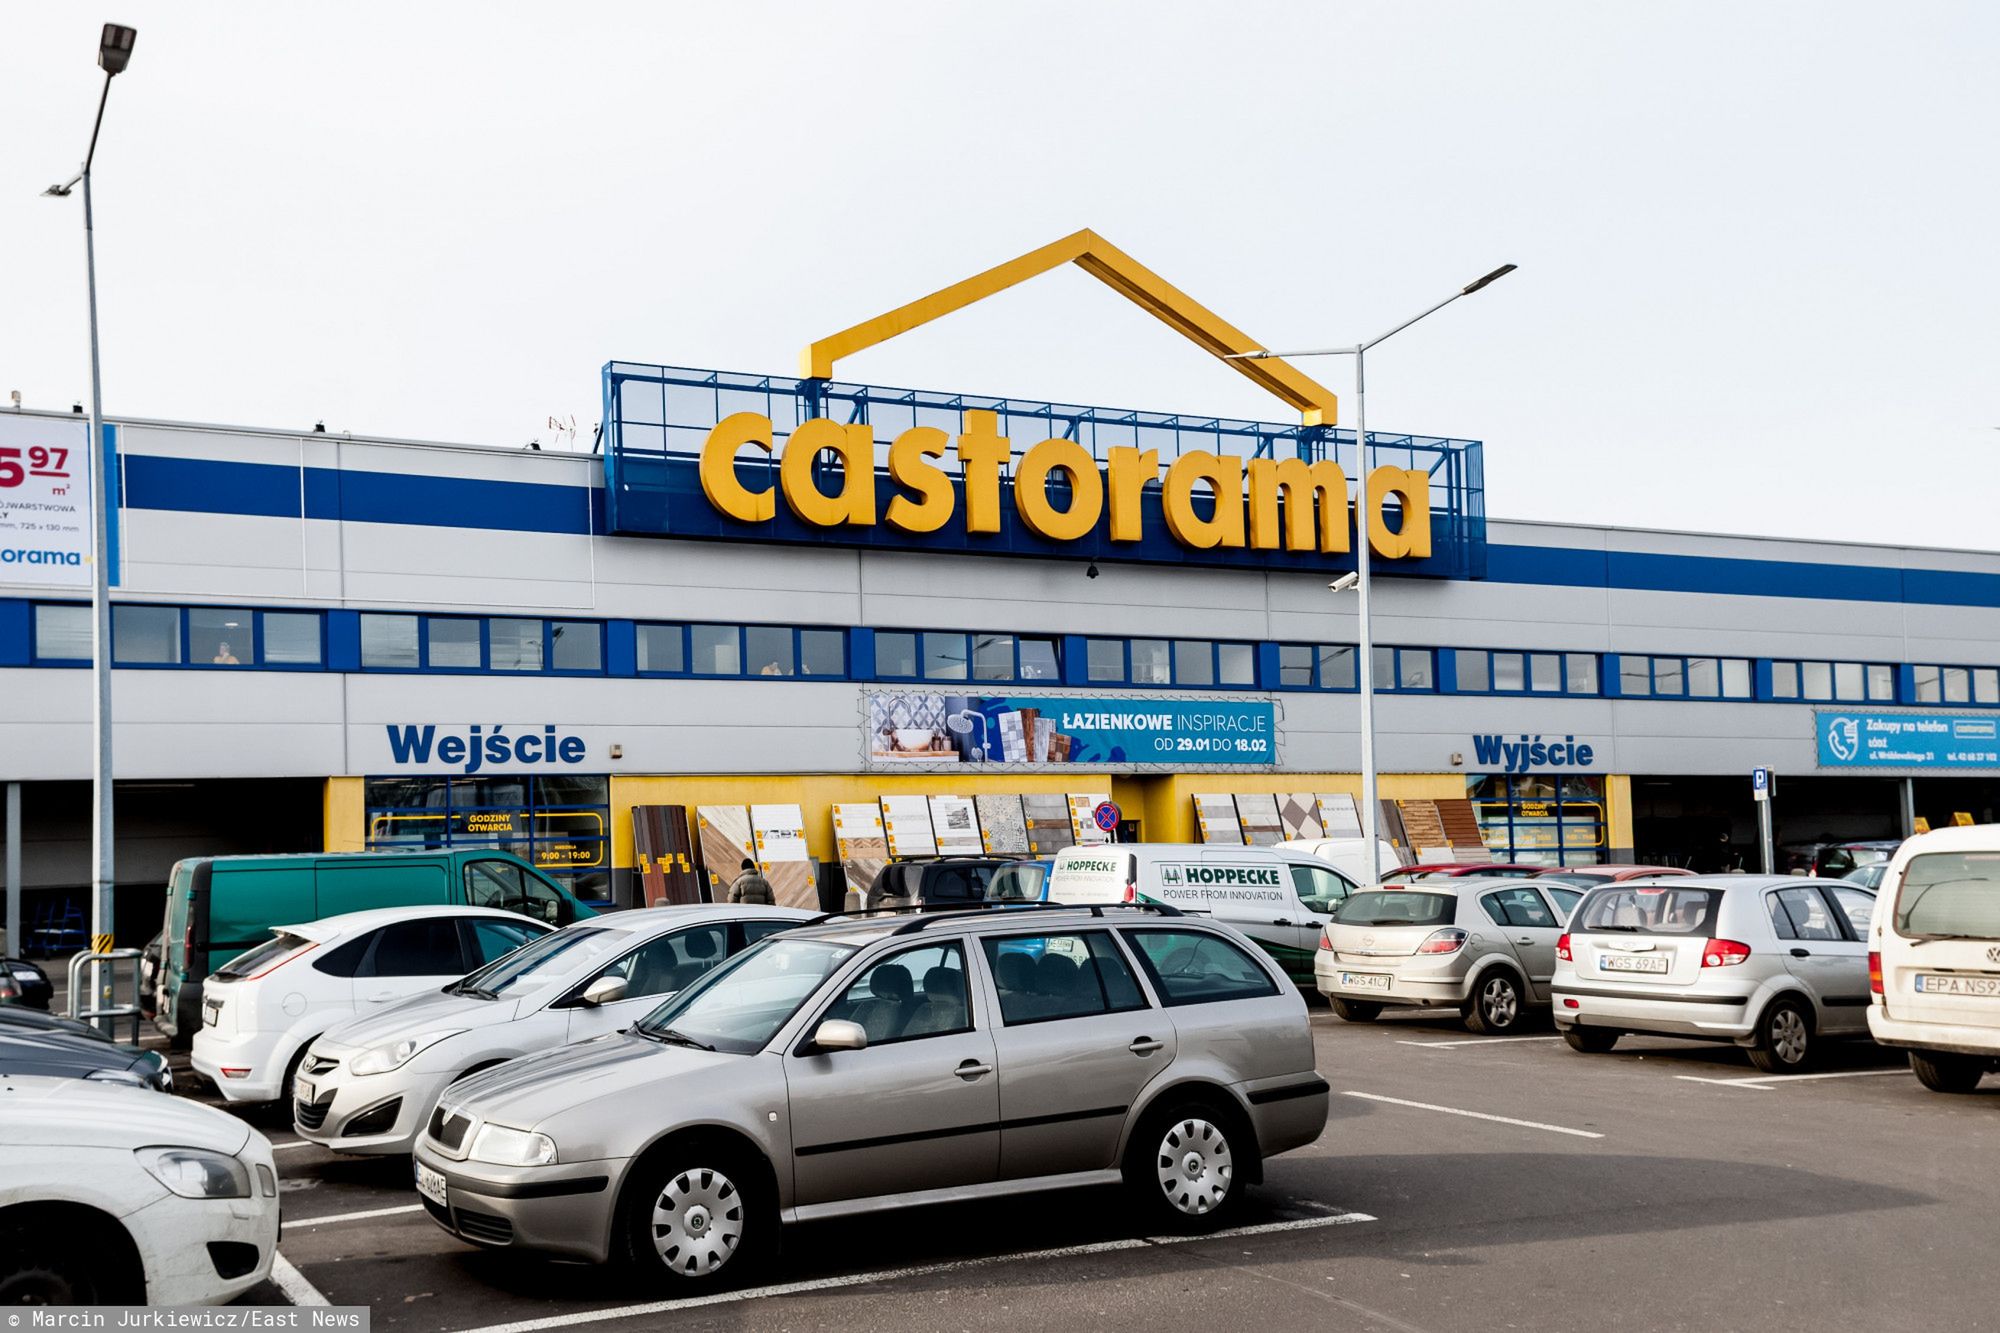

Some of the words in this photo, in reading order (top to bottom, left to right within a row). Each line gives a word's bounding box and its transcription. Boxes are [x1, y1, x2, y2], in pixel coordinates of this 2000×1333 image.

[28, 446, 69, 470] 97
[700, 409, 1432, 560] castorama
[1, 549, 80, 566] orama
[1062, 713, 1172, 731] ŁAZIENKOWE
[1177, 714, 1266, 732] INSPIRACJE
[1866, 719, 1901, 734] Zakupy
[1903, 722, 1915, 731] na
[1917, 720, 1948, 732] telefon
[386, 725, 586, 773] Wejście
[1154, 738, 1173, 751] OD
[1176, 738, 1210, 751] 29.01
[1212, 738, 1231, 751] DO
[1234, 739, 1267, 752] 18.02
[1472, 735, 1593, 773] Wyjście
[469, 814, 511, 823] GODZINY
[468, 823, 512, 832] OTWARCIA
[541, 851, 560, 860] 9:00
[568, 851, 591, 859] 19:00
[1067, 861, 1117, 872] HOPPECKE
[1185, 868, 1280, 885] HOPPECKE
[1163, 889, 1199, 899] POWER
[1201, 890, 1228, 900] FROM
[1229, 891, 1283, 901] INNOVATION
[1608, 957, 1632, 969] WGS
[1926, 977, 1959, 992] EPA
